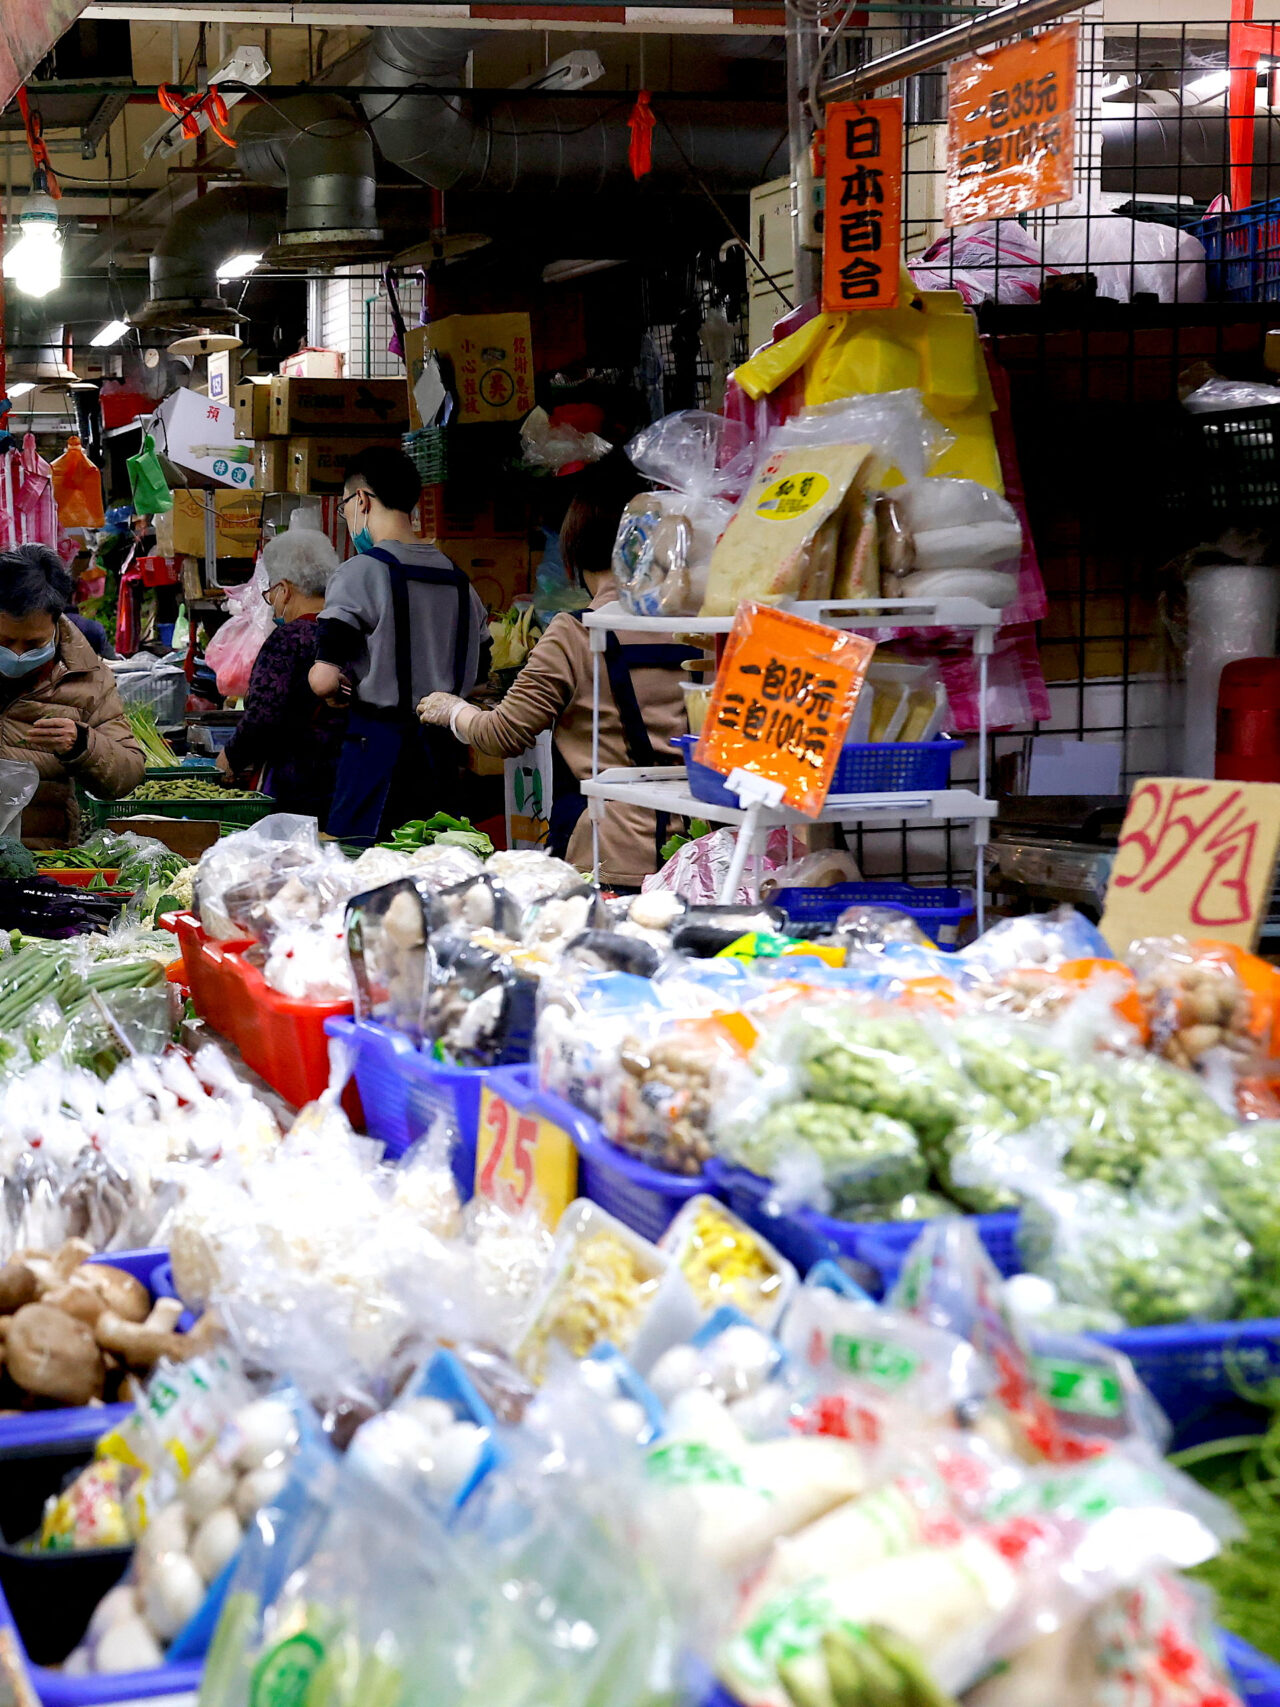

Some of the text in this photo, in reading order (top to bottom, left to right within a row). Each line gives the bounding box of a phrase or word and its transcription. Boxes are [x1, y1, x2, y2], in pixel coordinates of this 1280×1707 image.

[840, 115, 883, 300] 日本百合
[717, 698, 829, 769] 三包100元
[739, 657, 838, 721] 一包35元
[480, 1098, 538, 1206] 25
